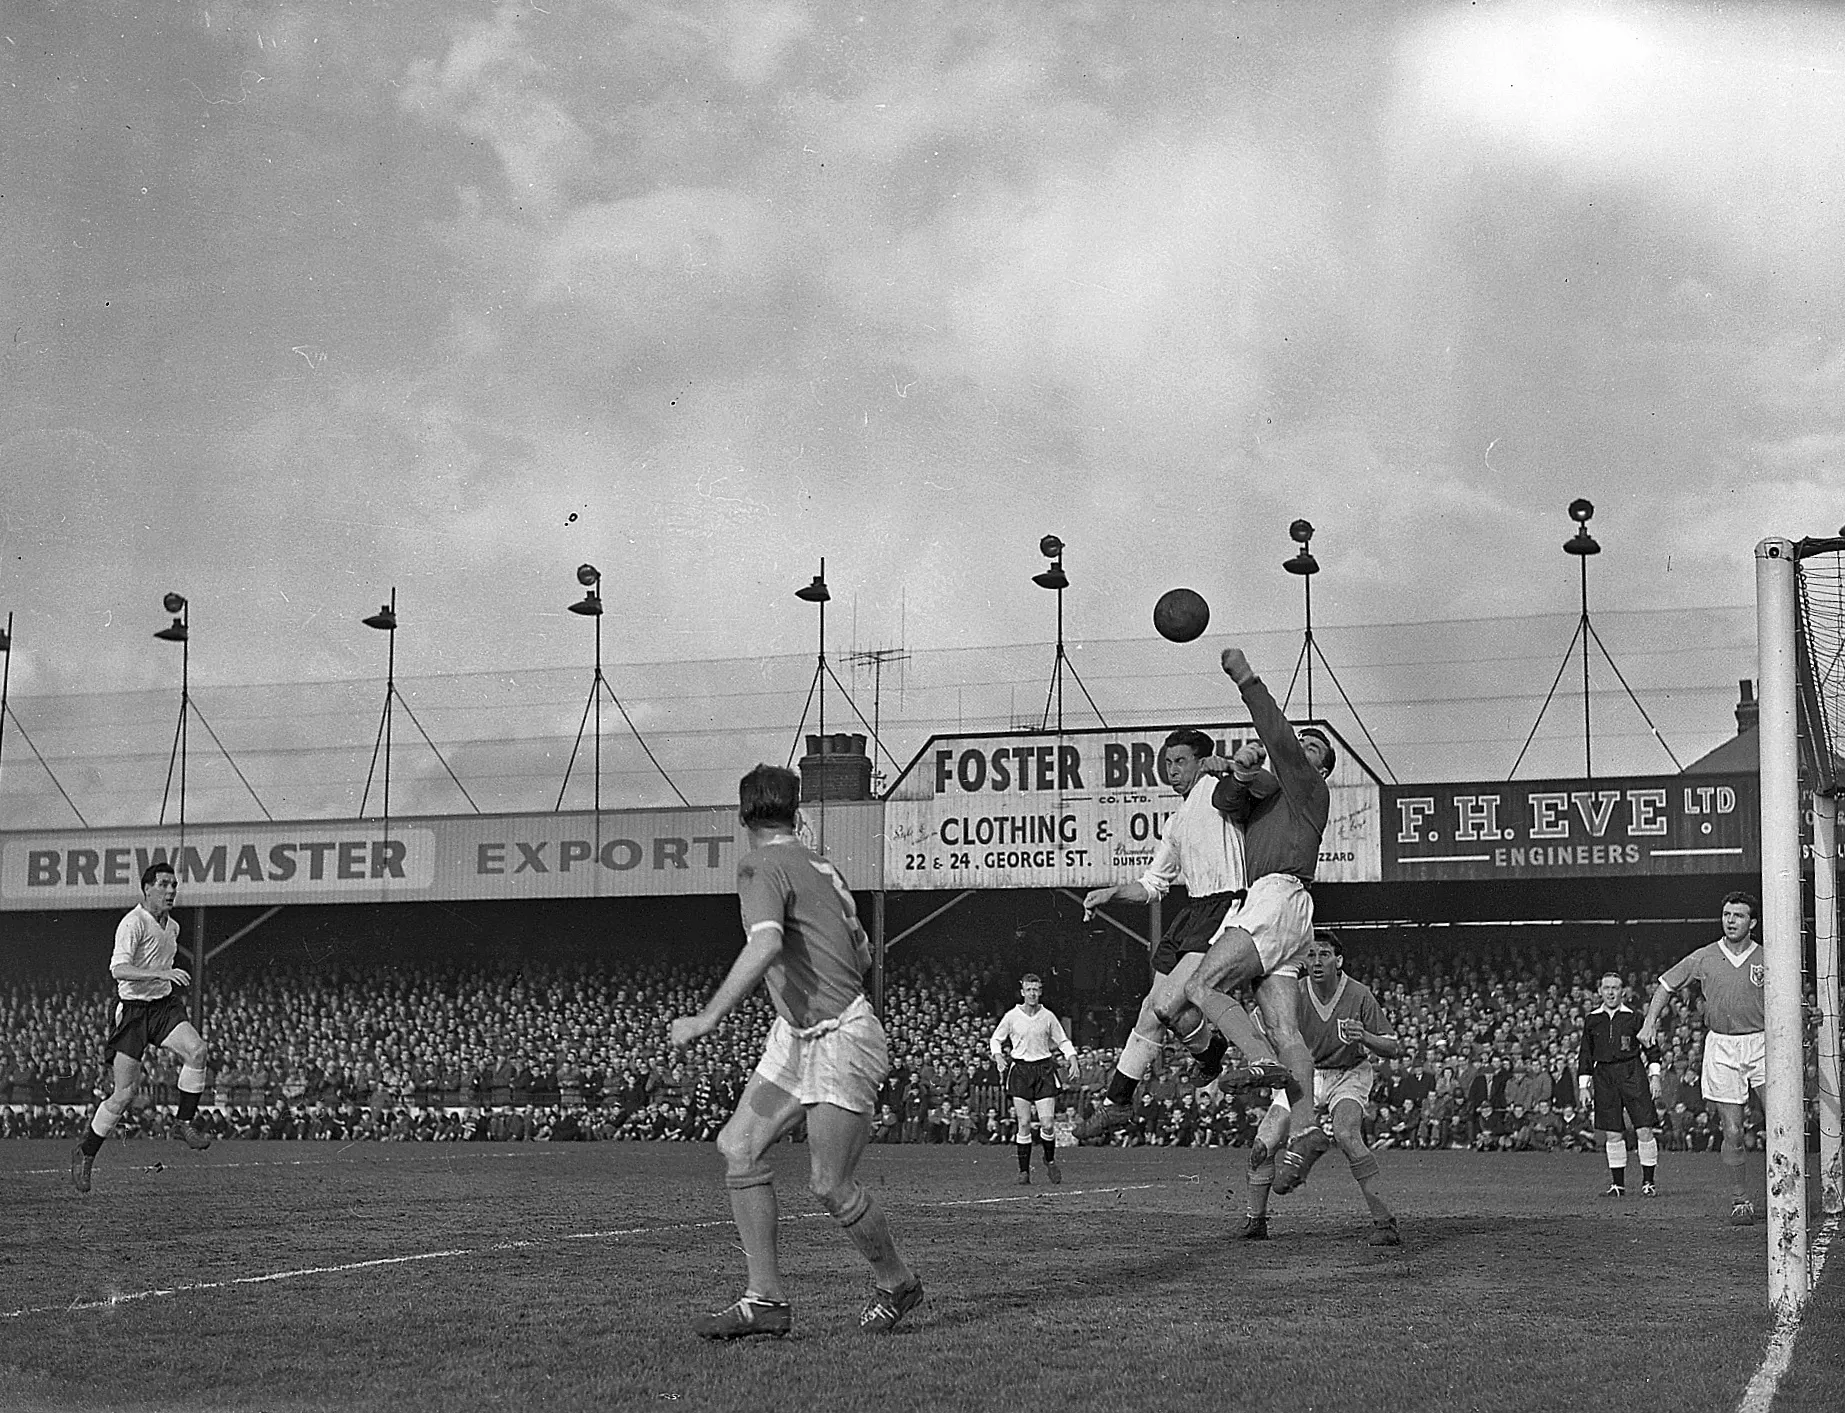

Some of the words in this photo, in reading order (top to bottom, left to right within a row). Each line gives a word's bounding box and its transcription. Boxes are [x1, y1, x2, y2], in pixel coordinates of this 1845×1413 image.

[935, 745, 1085, 793] FOSTER
[1124, 795, 1151, 803] LTD.
[1397, 797, 1439, 842] F.
[1454, 795, 1514, 840] H.
[1529, 789, 1667, 837] EVE
[940, 814, 1077, 846] CLOTHING
[1096, 820, 1113, 842] &
[28, 840, 406, 887] BREWMASTER
[477, 835, 735, 875] EXPORT
[905, 854, 926, 870] 22
[933, 857, 943, 869] &
[1065, 849, 1092, 867] ST.
[1495, 844, 1640, 867] ENGINEERS
